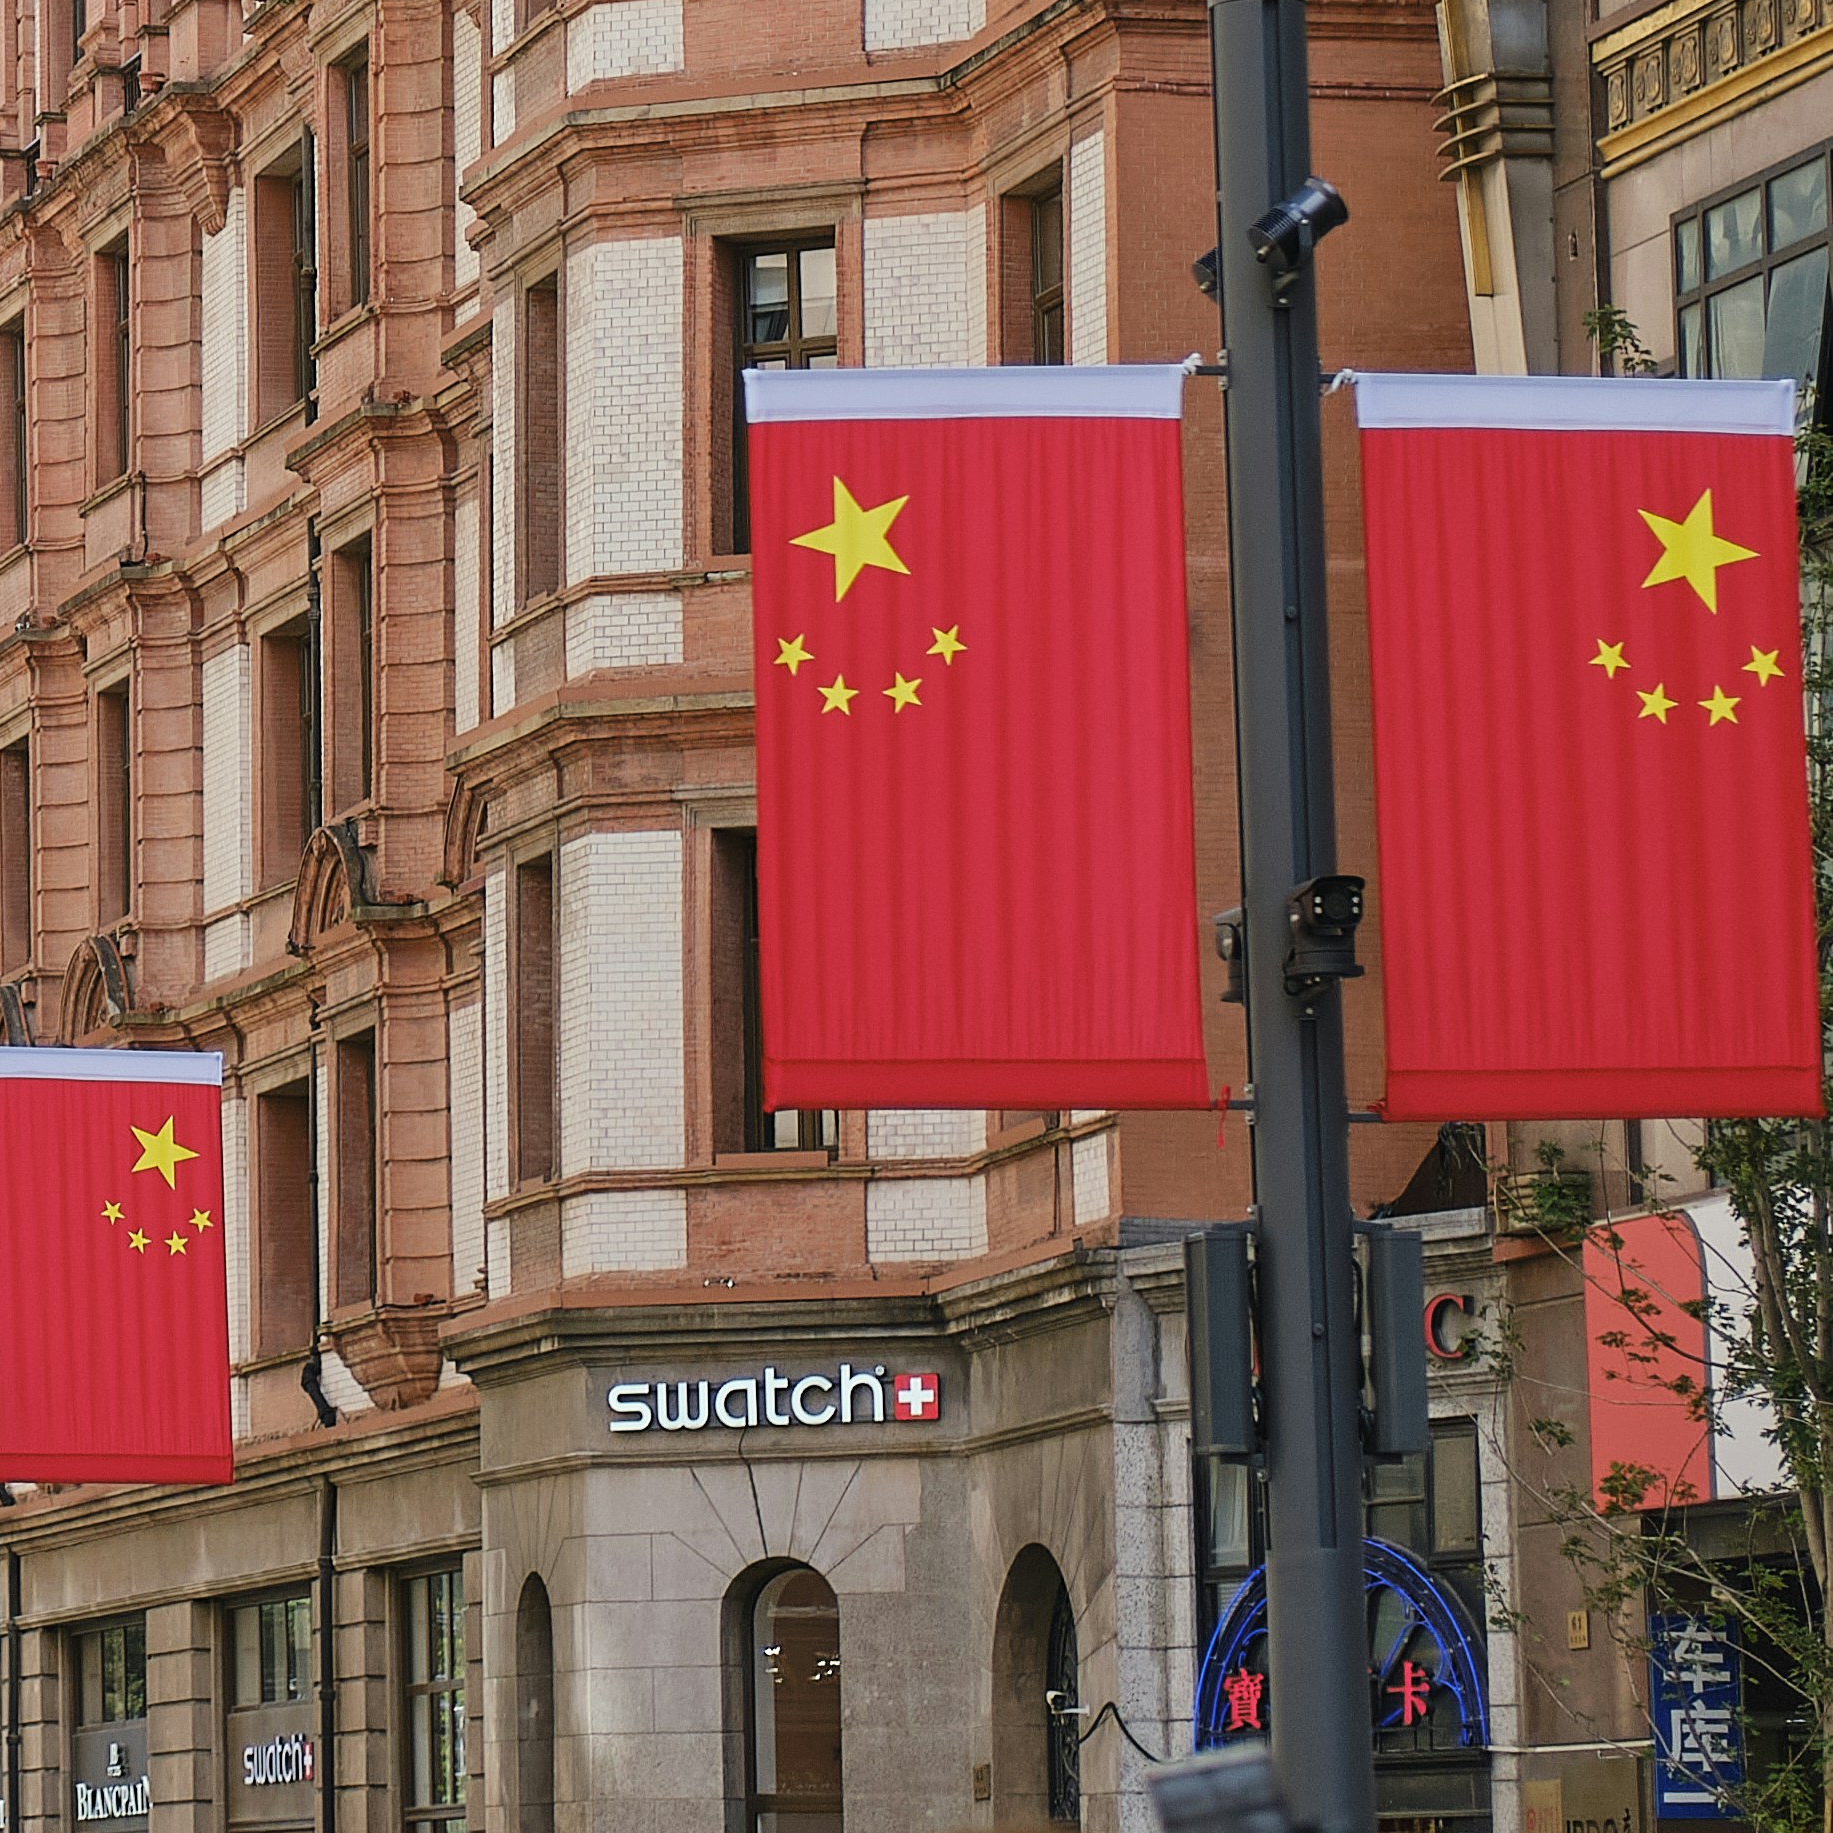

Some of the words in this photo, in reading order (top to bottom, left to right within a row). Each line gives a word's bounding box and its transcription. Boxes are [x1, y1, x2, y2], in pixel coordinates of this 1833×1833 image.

[608, 1363, 884, 1432] swatch
[1663, 1624, 1733, 1773] 车库
[243, 1732, 303, 1786] swatch
